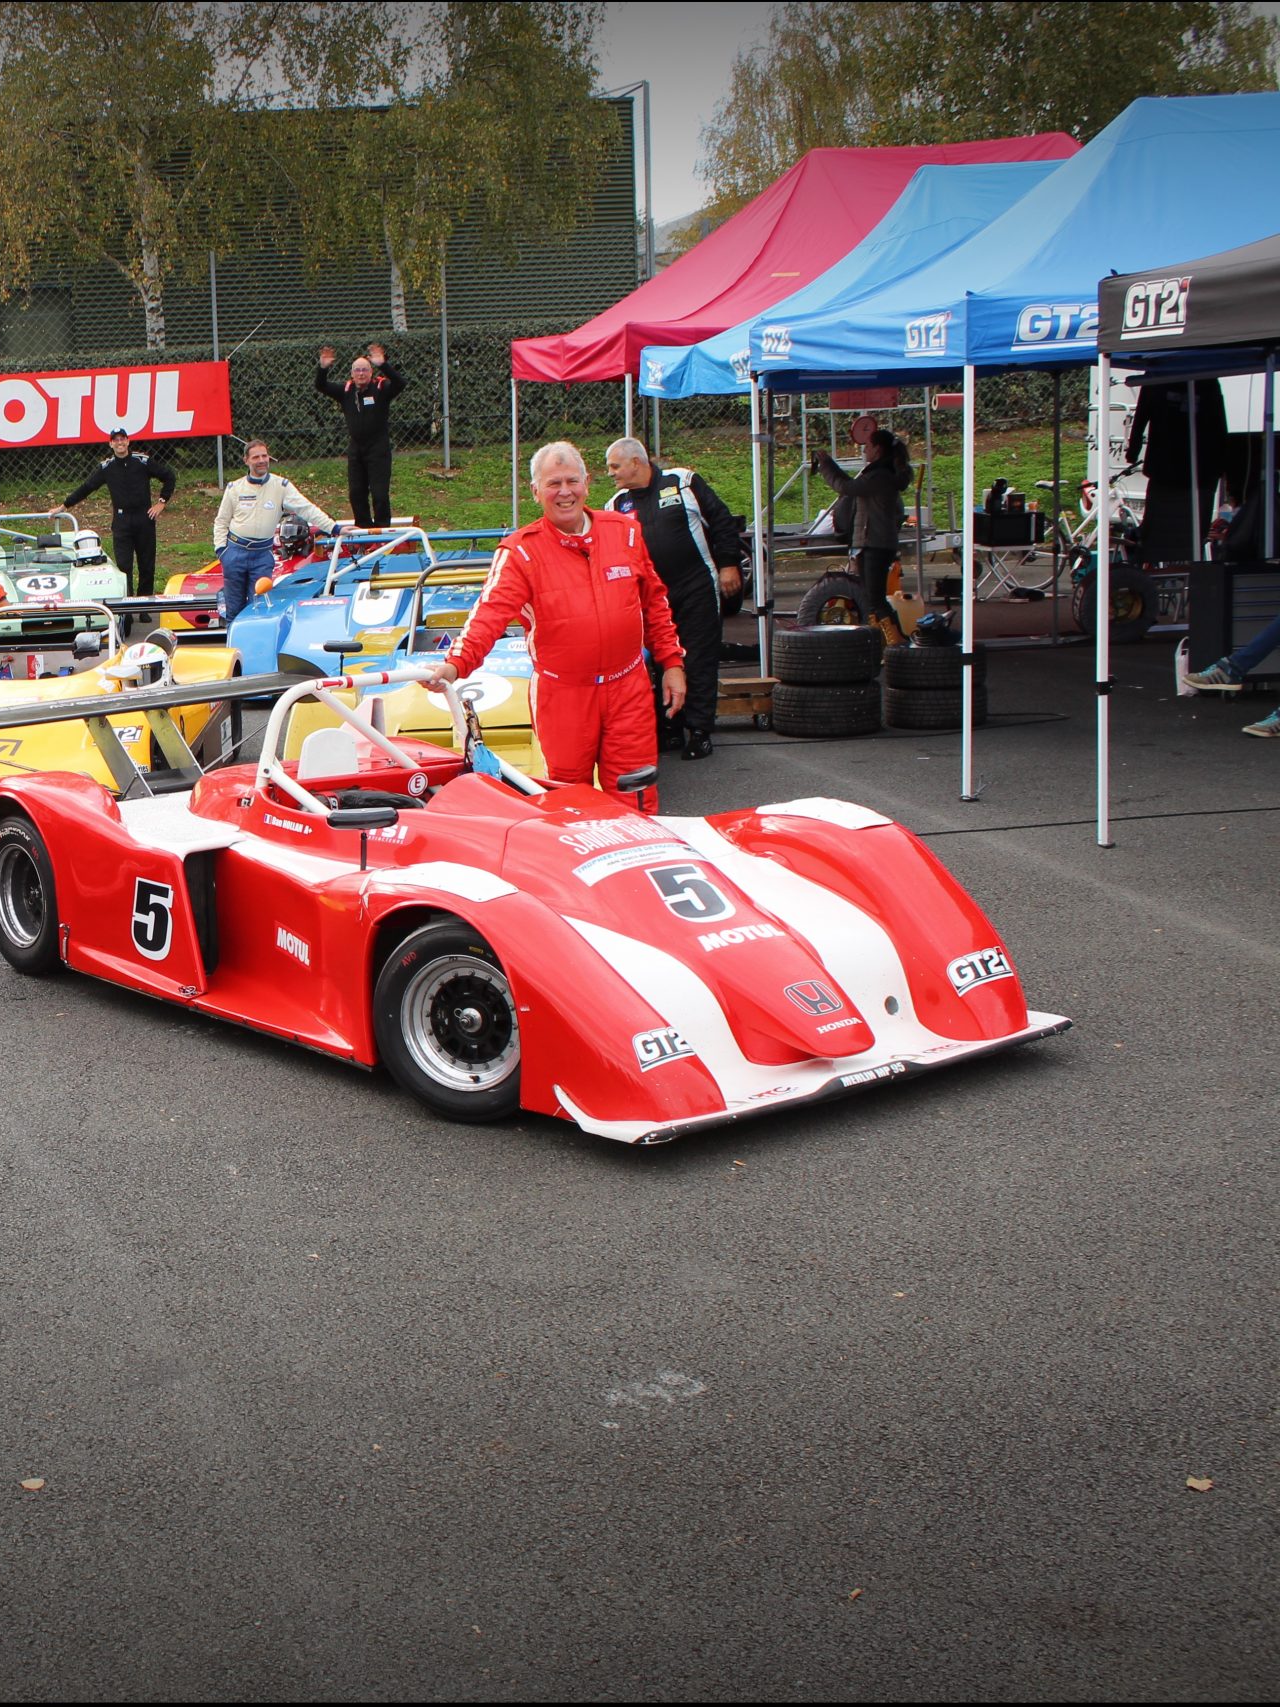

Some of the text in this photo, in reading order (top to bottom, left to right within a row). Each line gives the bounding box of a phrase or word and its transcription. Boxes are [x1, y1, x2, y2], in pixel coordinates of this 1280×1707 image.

[1124, 278, 1190, 328] GT2i
[906, 312, 951, 349] GT2i
[1018, 306, 1098, 342] GT2
[27, 576, 58, 590] 43
[414, 777, 421, 789] E
[559, 825, 633, 855] SAVANE
[646, 864, 730, 920] 5
[132, 877, 173, 955] 5
[276, 927, 310, 967] MOTUL
[697, 923, 786, 952] MOTUL
[947, 946, 1011, 987] GT2i
[816, 1017, 862, 1034] HONDA
[633, 1028, 692, 1062] GT2
[839, 1062, 906, 1088] MERLIN MP 95
